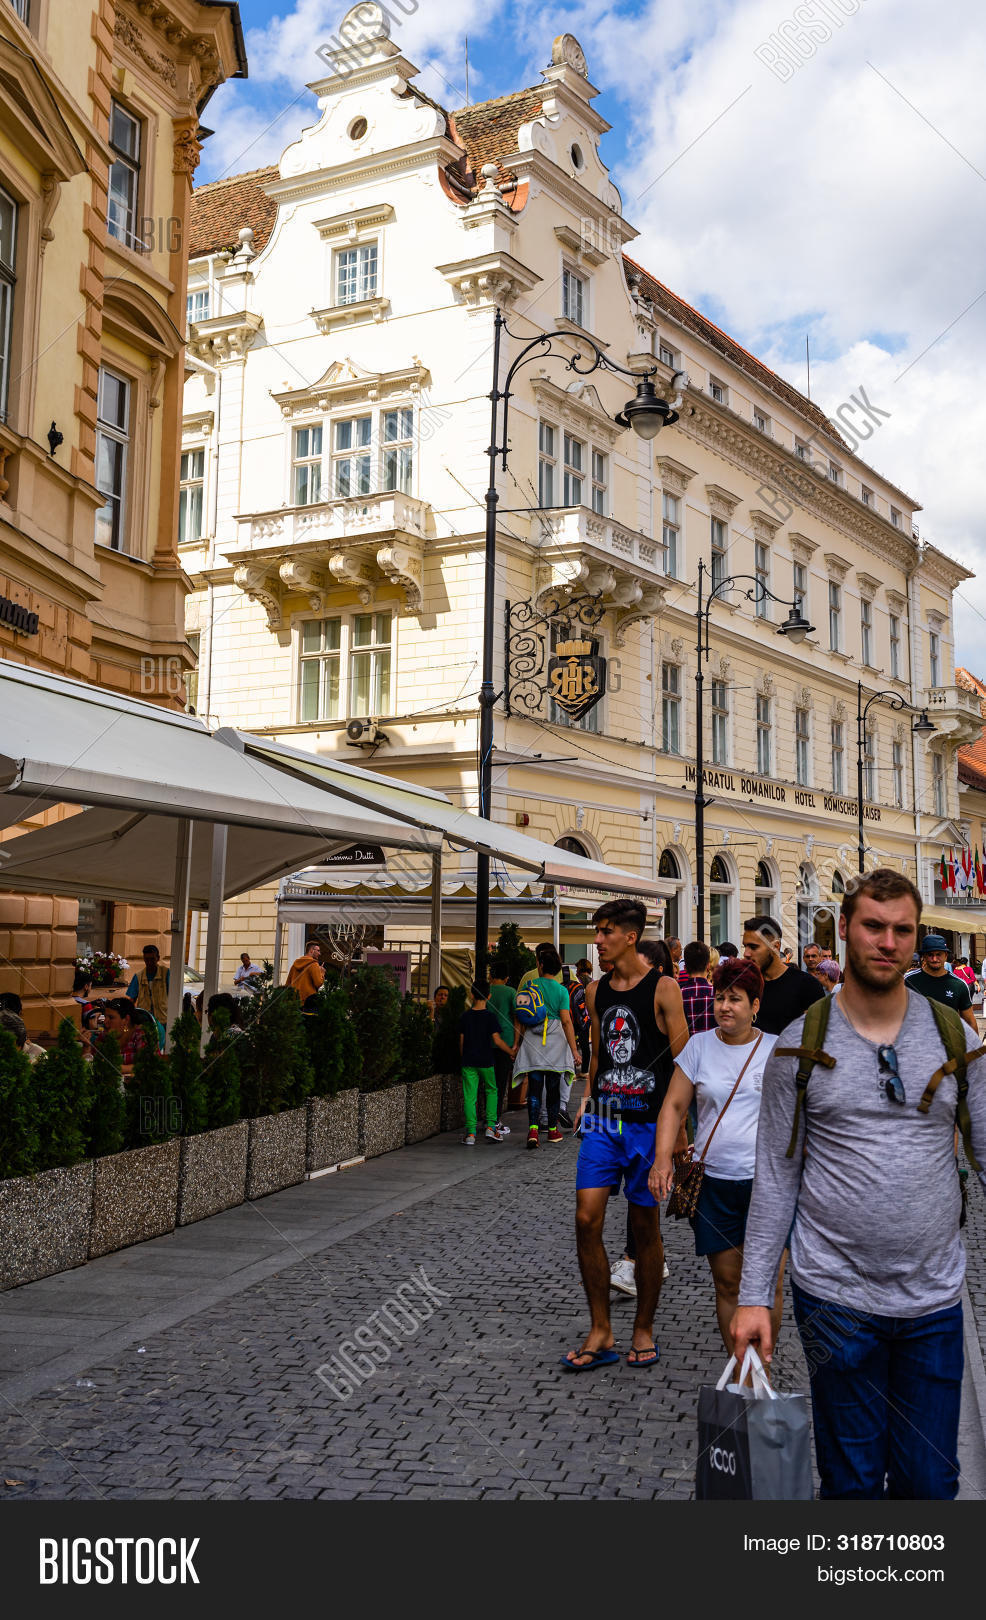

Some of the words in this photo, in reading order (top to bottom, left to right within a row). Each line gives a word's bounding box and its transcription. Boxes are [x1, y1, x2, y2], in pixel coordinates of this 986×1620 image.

[685, 765, 736, 791] IMARATUL
[741, 778, 786, 802] ROMANILOR
[795, 791, 816, 808] HOTEL
[355, 850, 375, 861] Dutti
